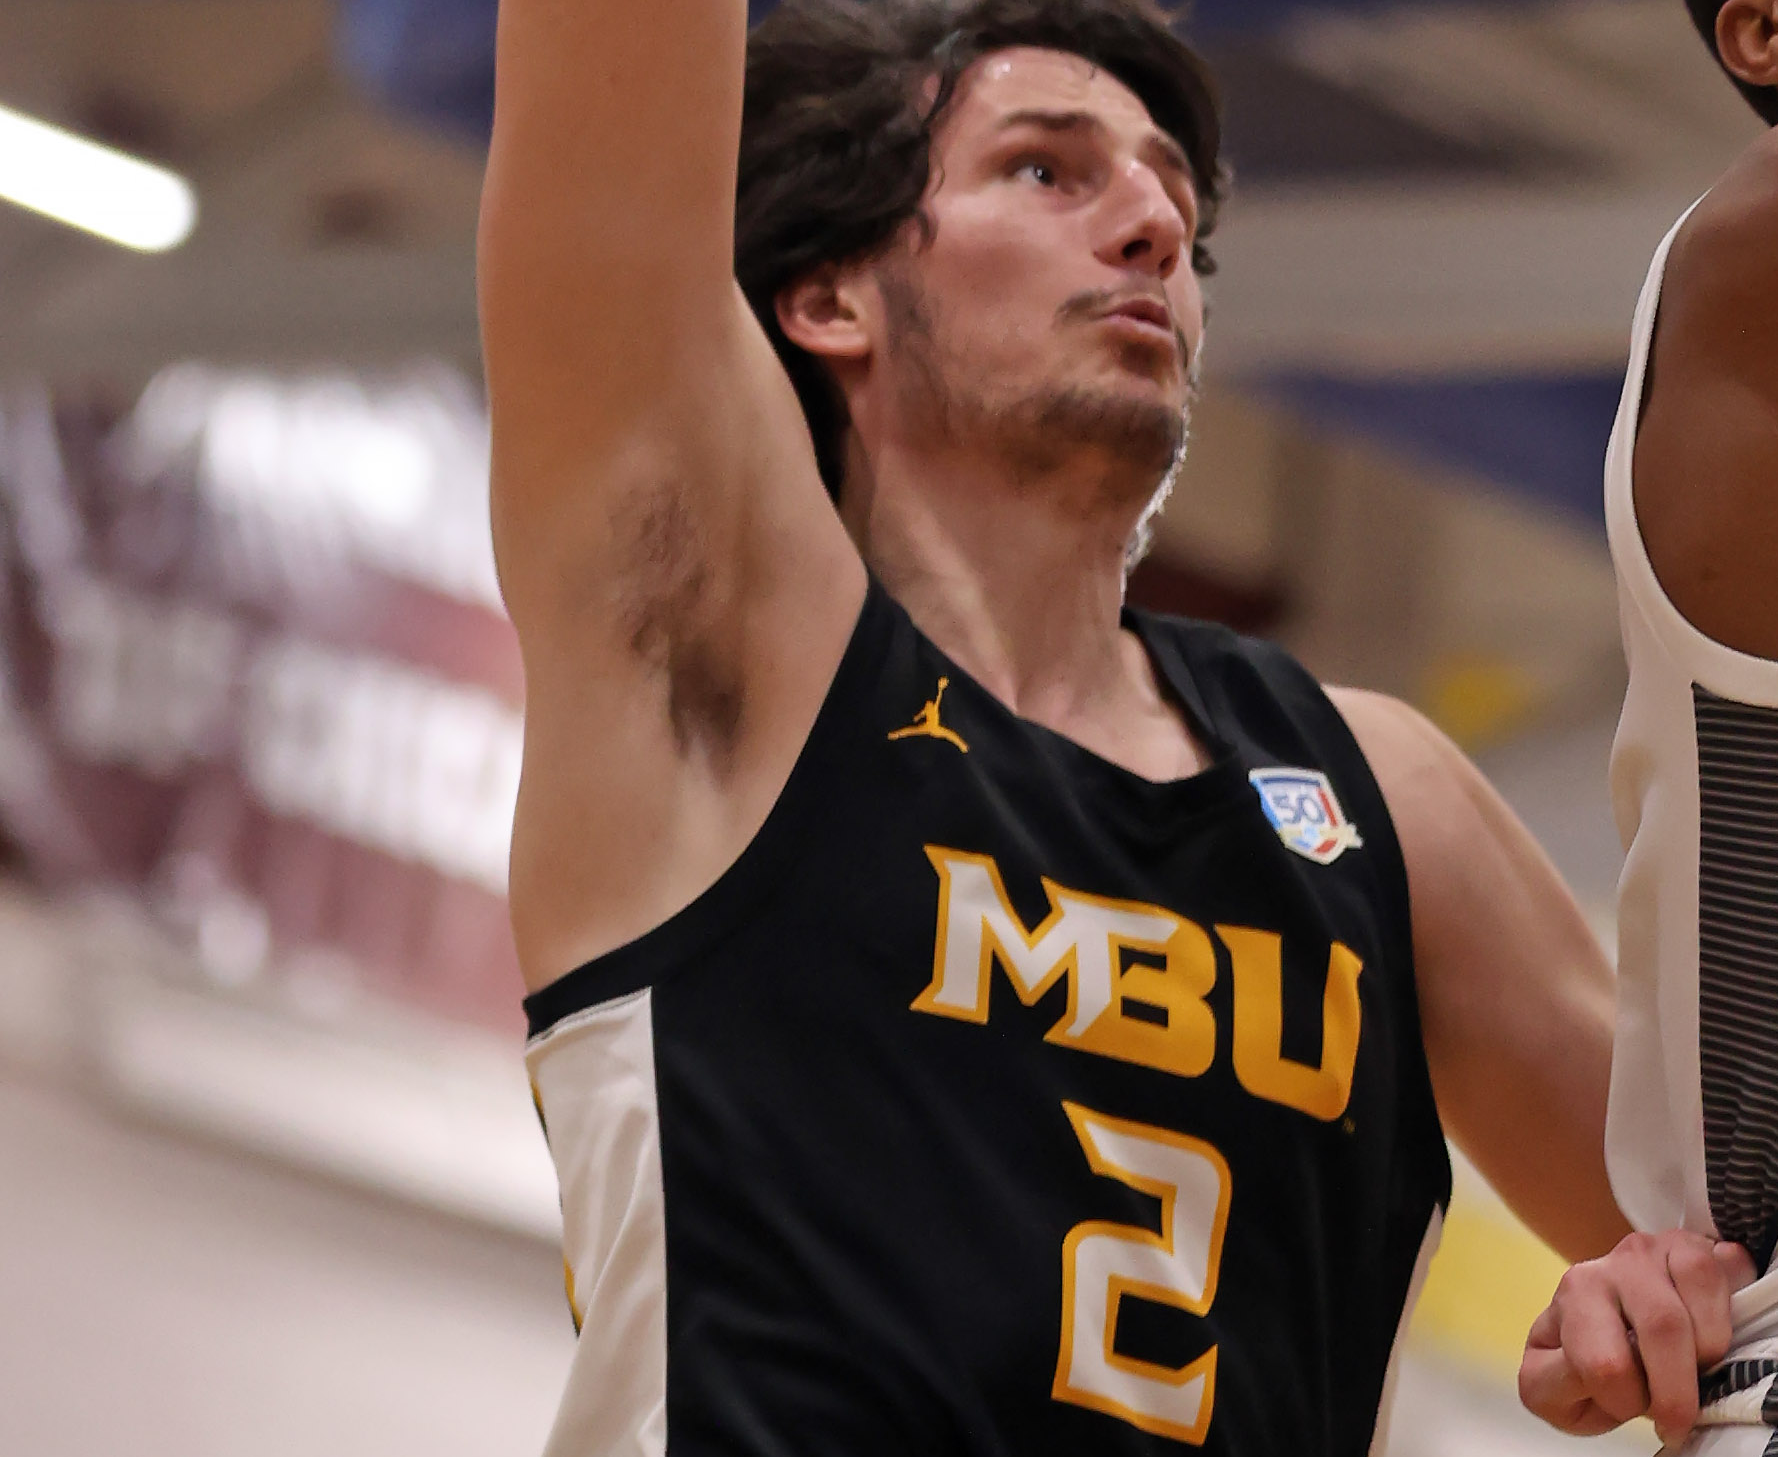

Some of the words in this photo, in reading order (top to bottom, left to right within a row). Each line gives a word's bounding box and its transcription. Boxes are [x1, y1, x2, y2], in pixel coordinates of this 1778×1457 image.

[1272, 793, 1325, 825] 50
[909, 844, 1364, 1122] MBU
[1051, 1100, 1233, 1446] 2
